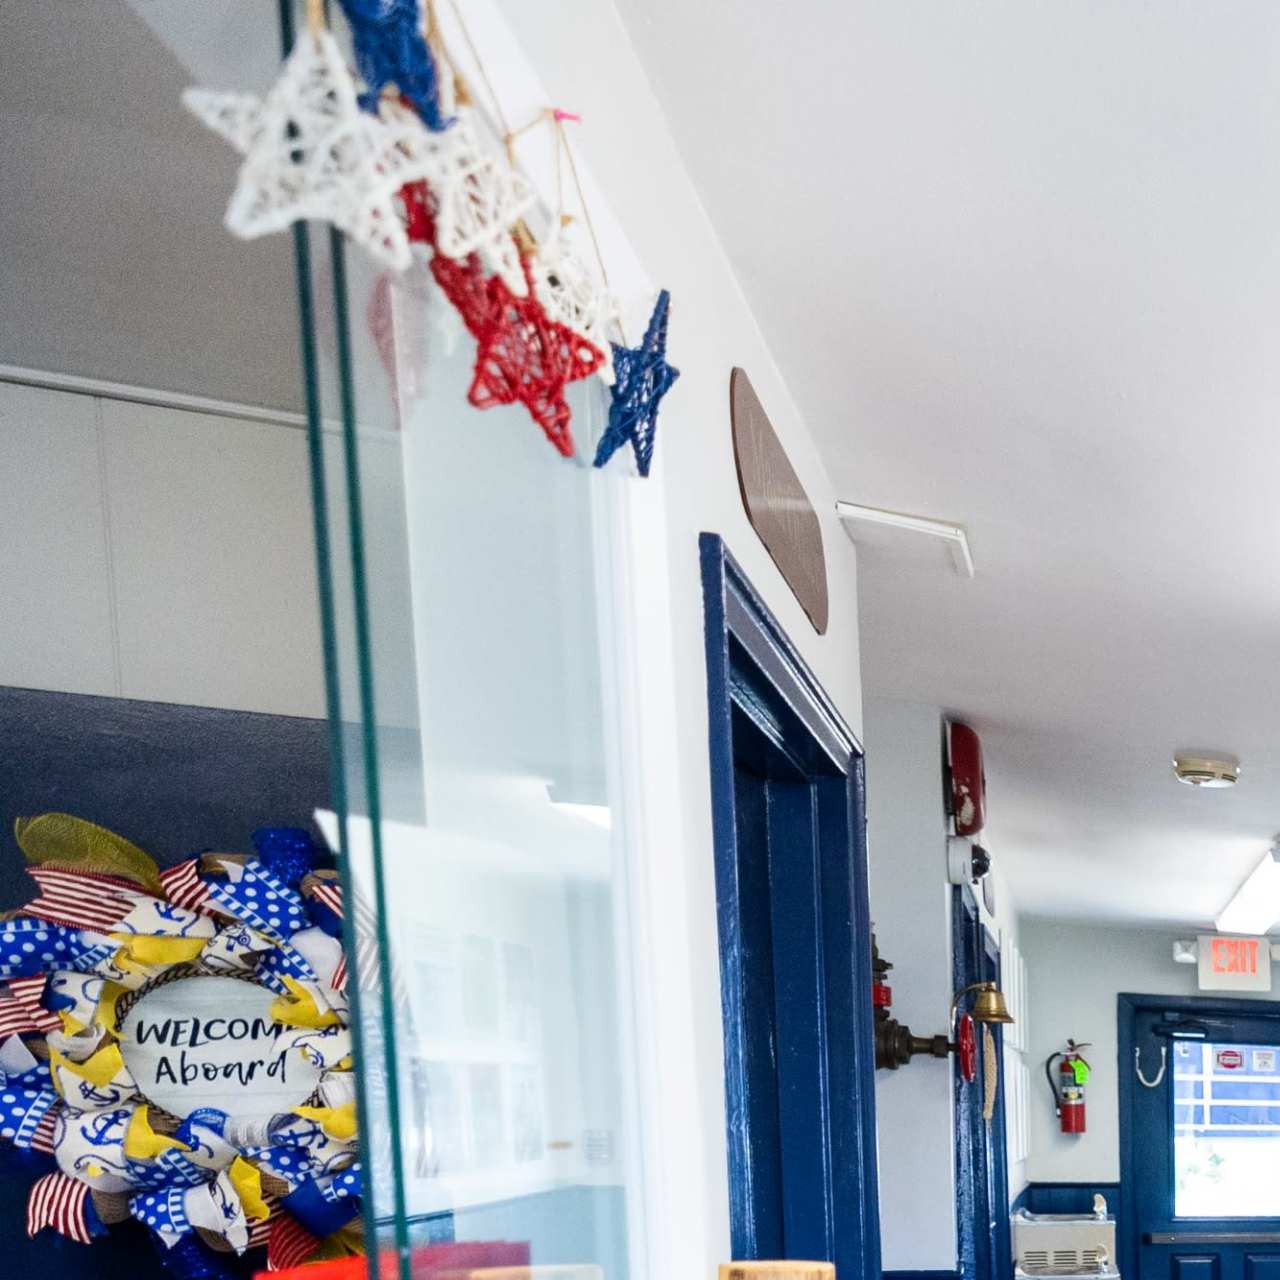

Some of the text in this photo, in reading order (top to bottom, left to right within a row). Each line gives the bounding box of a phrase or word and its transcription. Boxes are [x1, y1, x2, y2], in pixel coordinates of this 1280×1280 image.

[1210, 937, 1259, 977] EXIT
[136, 1016, 297, 1048] WELCOM
[155, 1049, 287, 1086] Aboard
